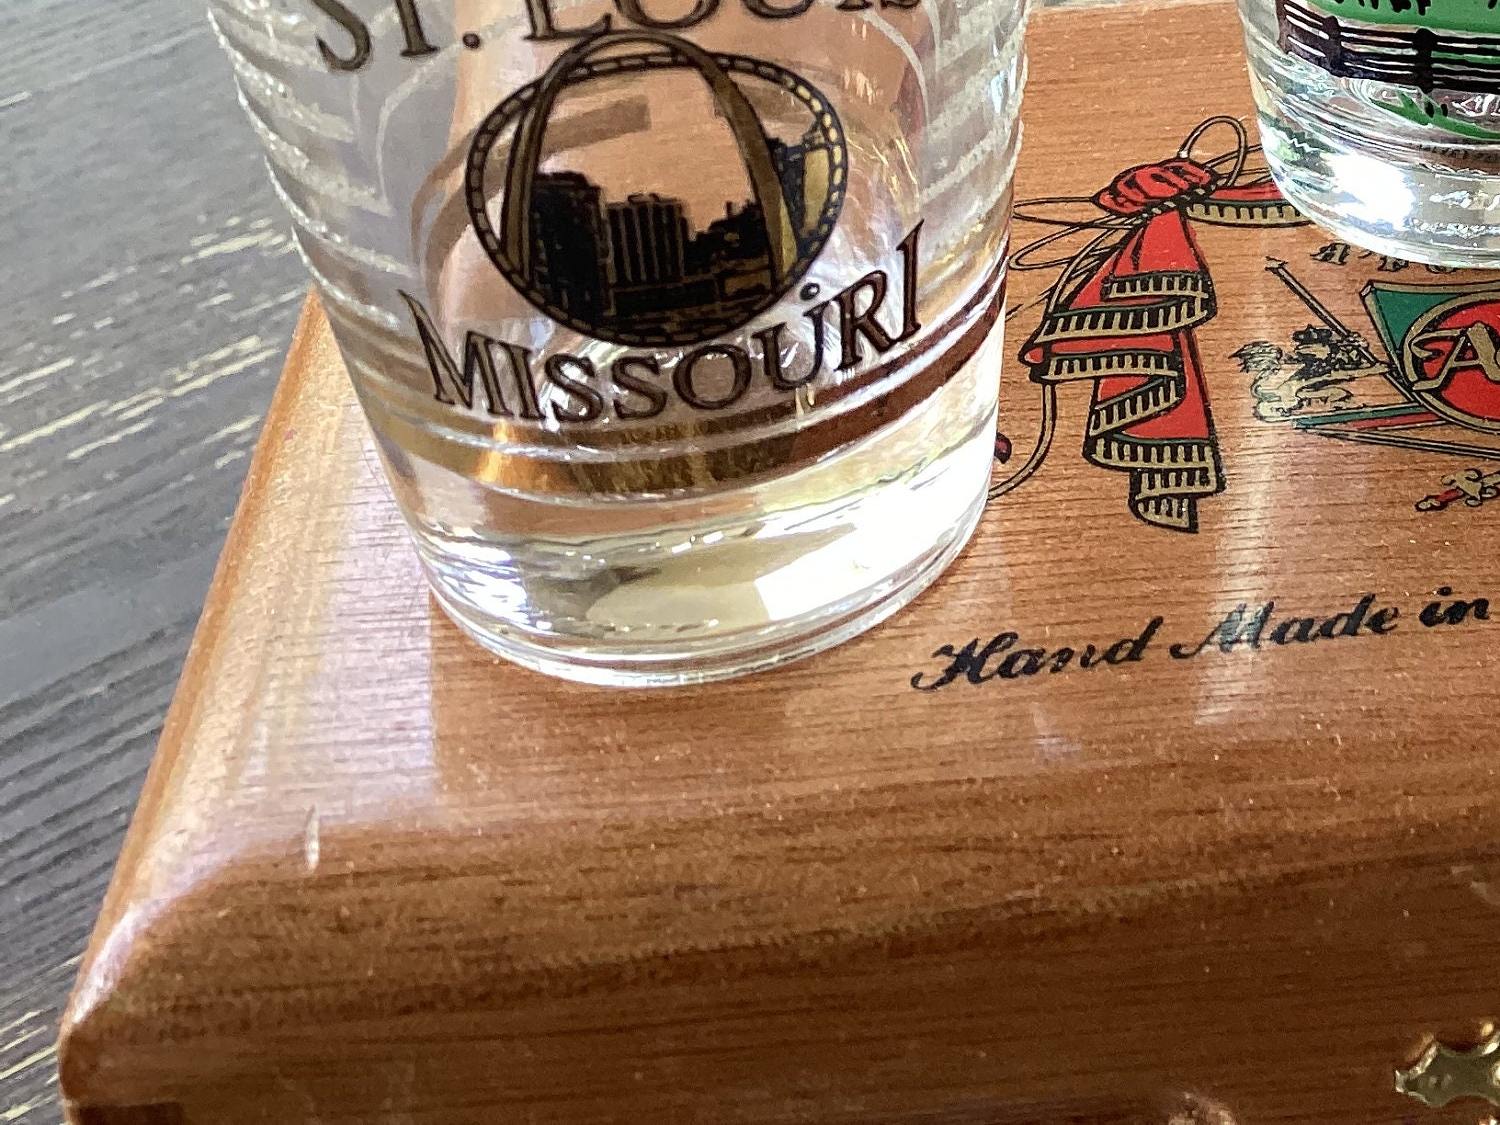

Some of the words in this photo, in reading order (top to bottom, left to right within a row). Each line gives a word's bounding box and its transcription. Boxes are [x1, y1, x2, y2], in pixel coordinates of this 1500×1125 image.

[398, 219, 926, 424] MISSOURI
[909, 615, 1164, 691] Hand
[1170, 593, 1400, 659] Made
[1418, 586, 1490, 627] in
